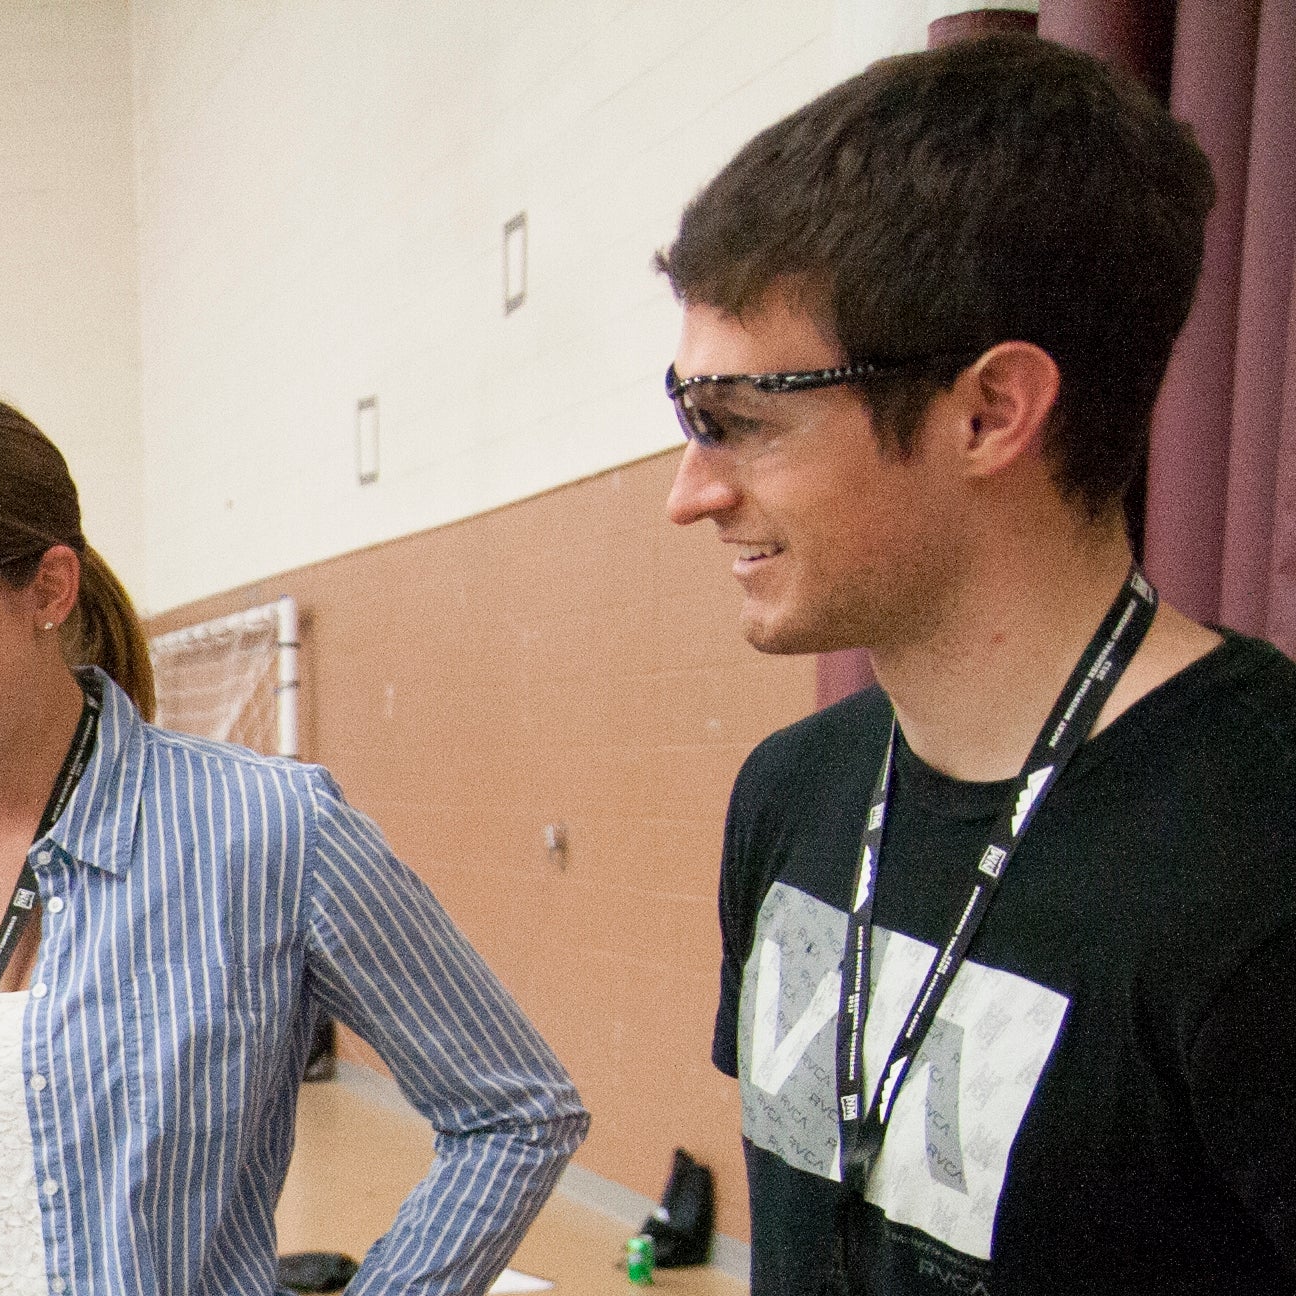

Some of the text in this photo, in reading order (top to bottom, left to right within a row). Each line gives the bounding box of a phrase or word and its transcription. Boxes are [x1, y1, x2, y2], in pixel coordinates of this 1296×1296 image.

[1048, 720, 1067, 748] ROCKY
[1064, 678, 1092, 721] MOUNTAIN
[918, 972, 940, 1014] MOUNTAIN
[788, 1136, 825, 1171] RVCA
[926, 1142, 963, 1184] RVCA
